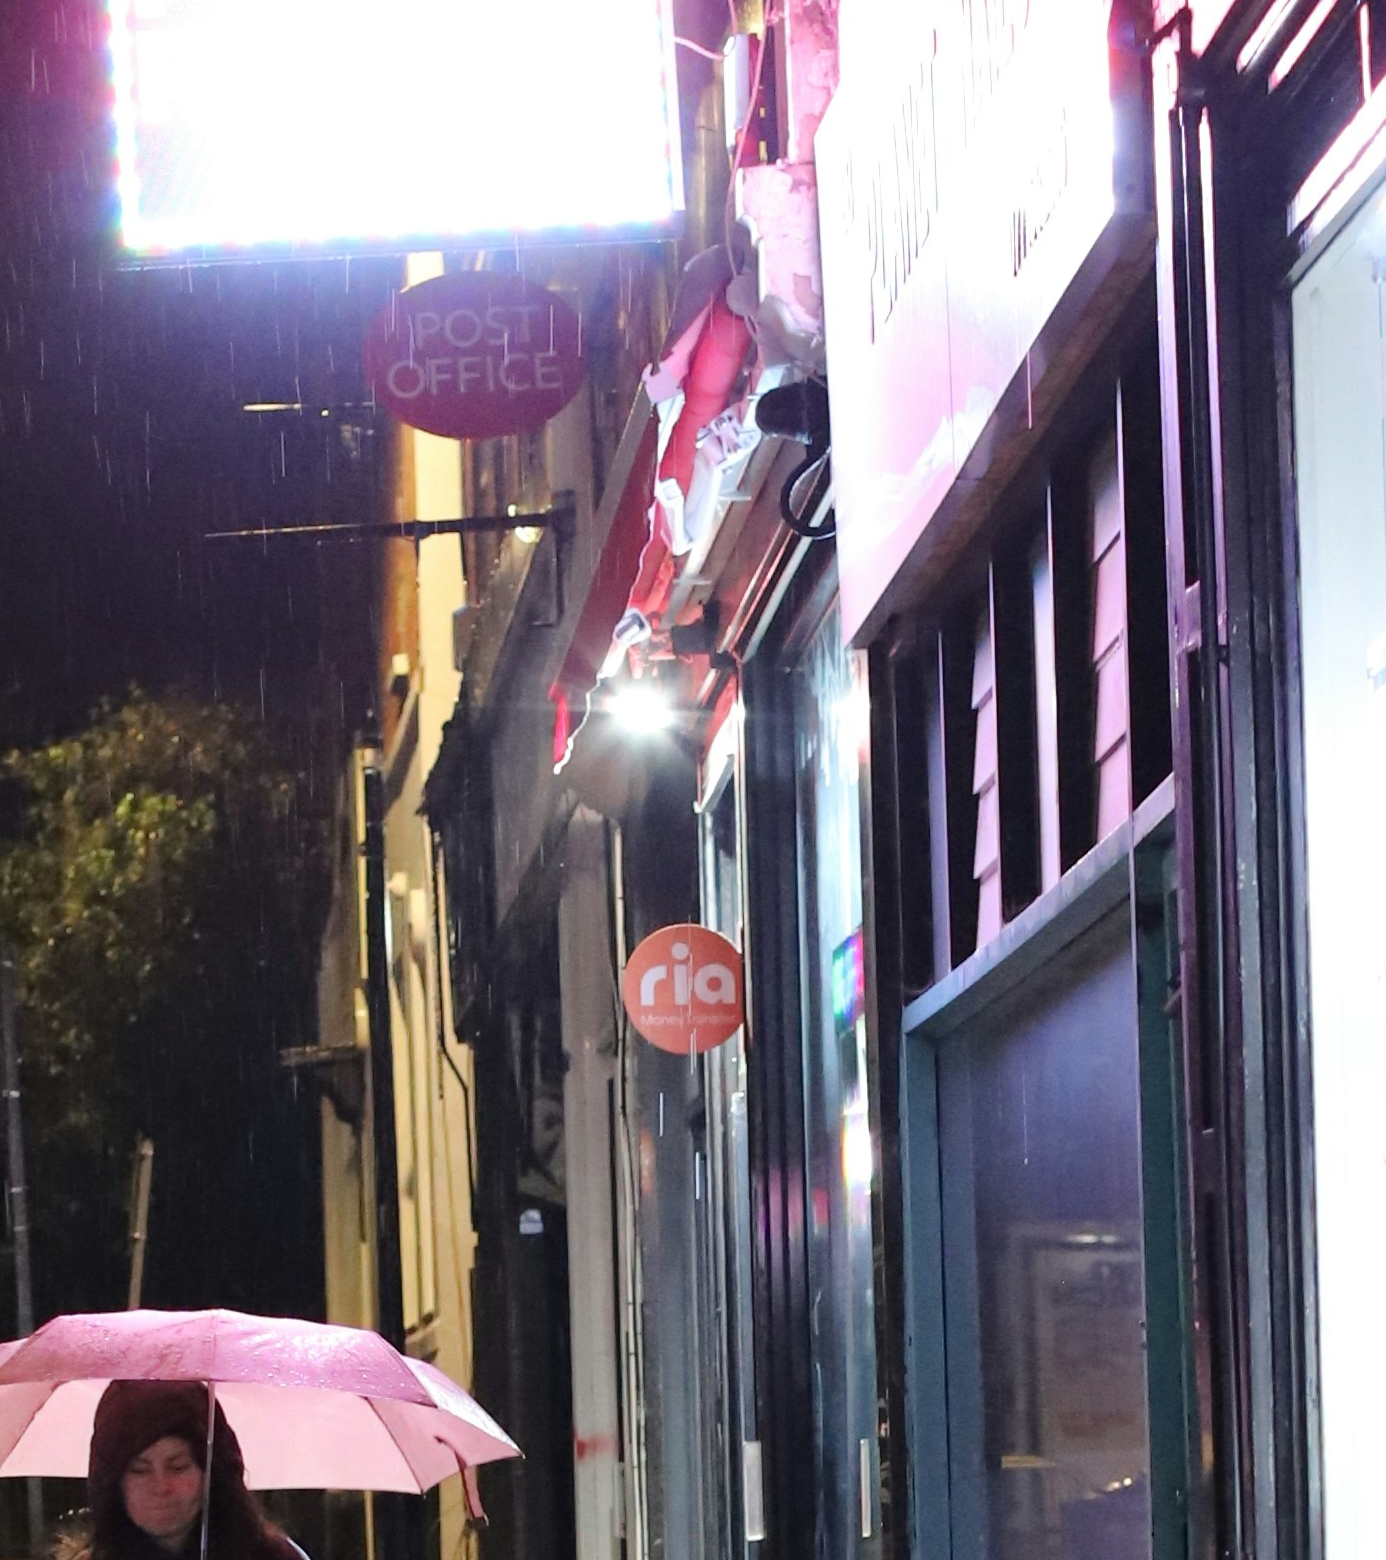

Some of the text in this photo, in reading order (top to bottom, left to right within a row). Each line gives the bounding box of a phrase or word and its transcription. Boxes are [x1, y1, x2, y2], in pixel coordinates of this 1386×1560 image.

[413, 305, 539, 350] POST
[386, 351, 564, 399] OFFICE
[639, 941, 737, 1007] ria
